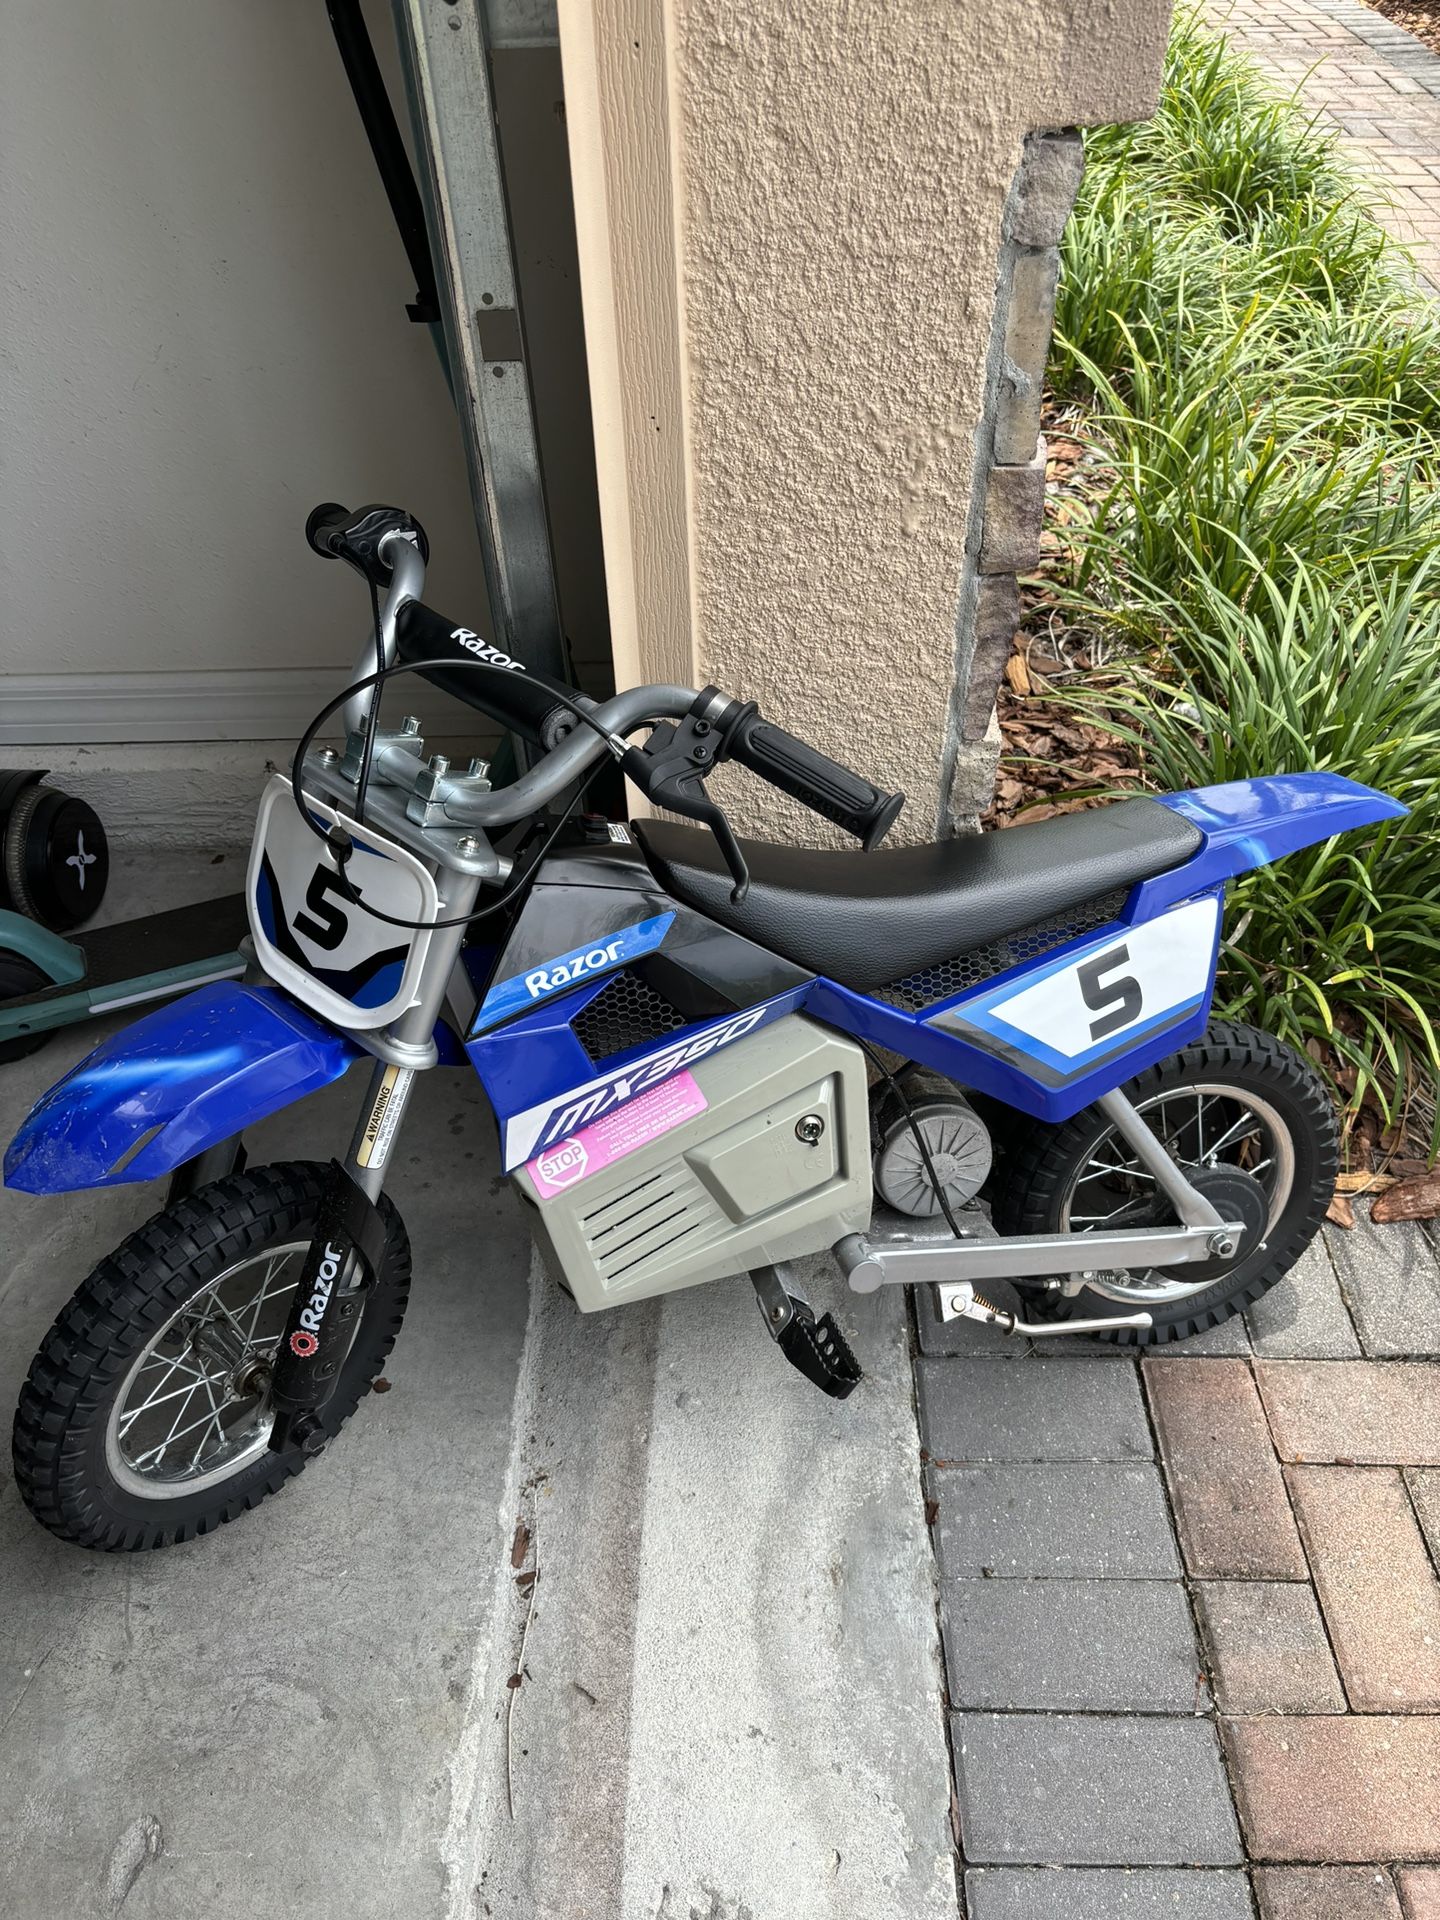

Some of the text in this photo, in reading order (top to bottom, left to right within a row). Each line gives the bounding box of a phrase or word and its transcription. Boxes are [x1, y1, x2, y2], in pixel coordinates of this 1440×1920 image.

[450, 628, 526, 670] Razor
[292, 862, 363, 951] 5
[525, 940, 624, 998] Razor
[1077, 944, 1143, 1042] 5
[367, 1086, 391, 1134] WARNING
[541, 1145, 583, 1178] STOP
[300, 1242, 341, 1331] Razor
